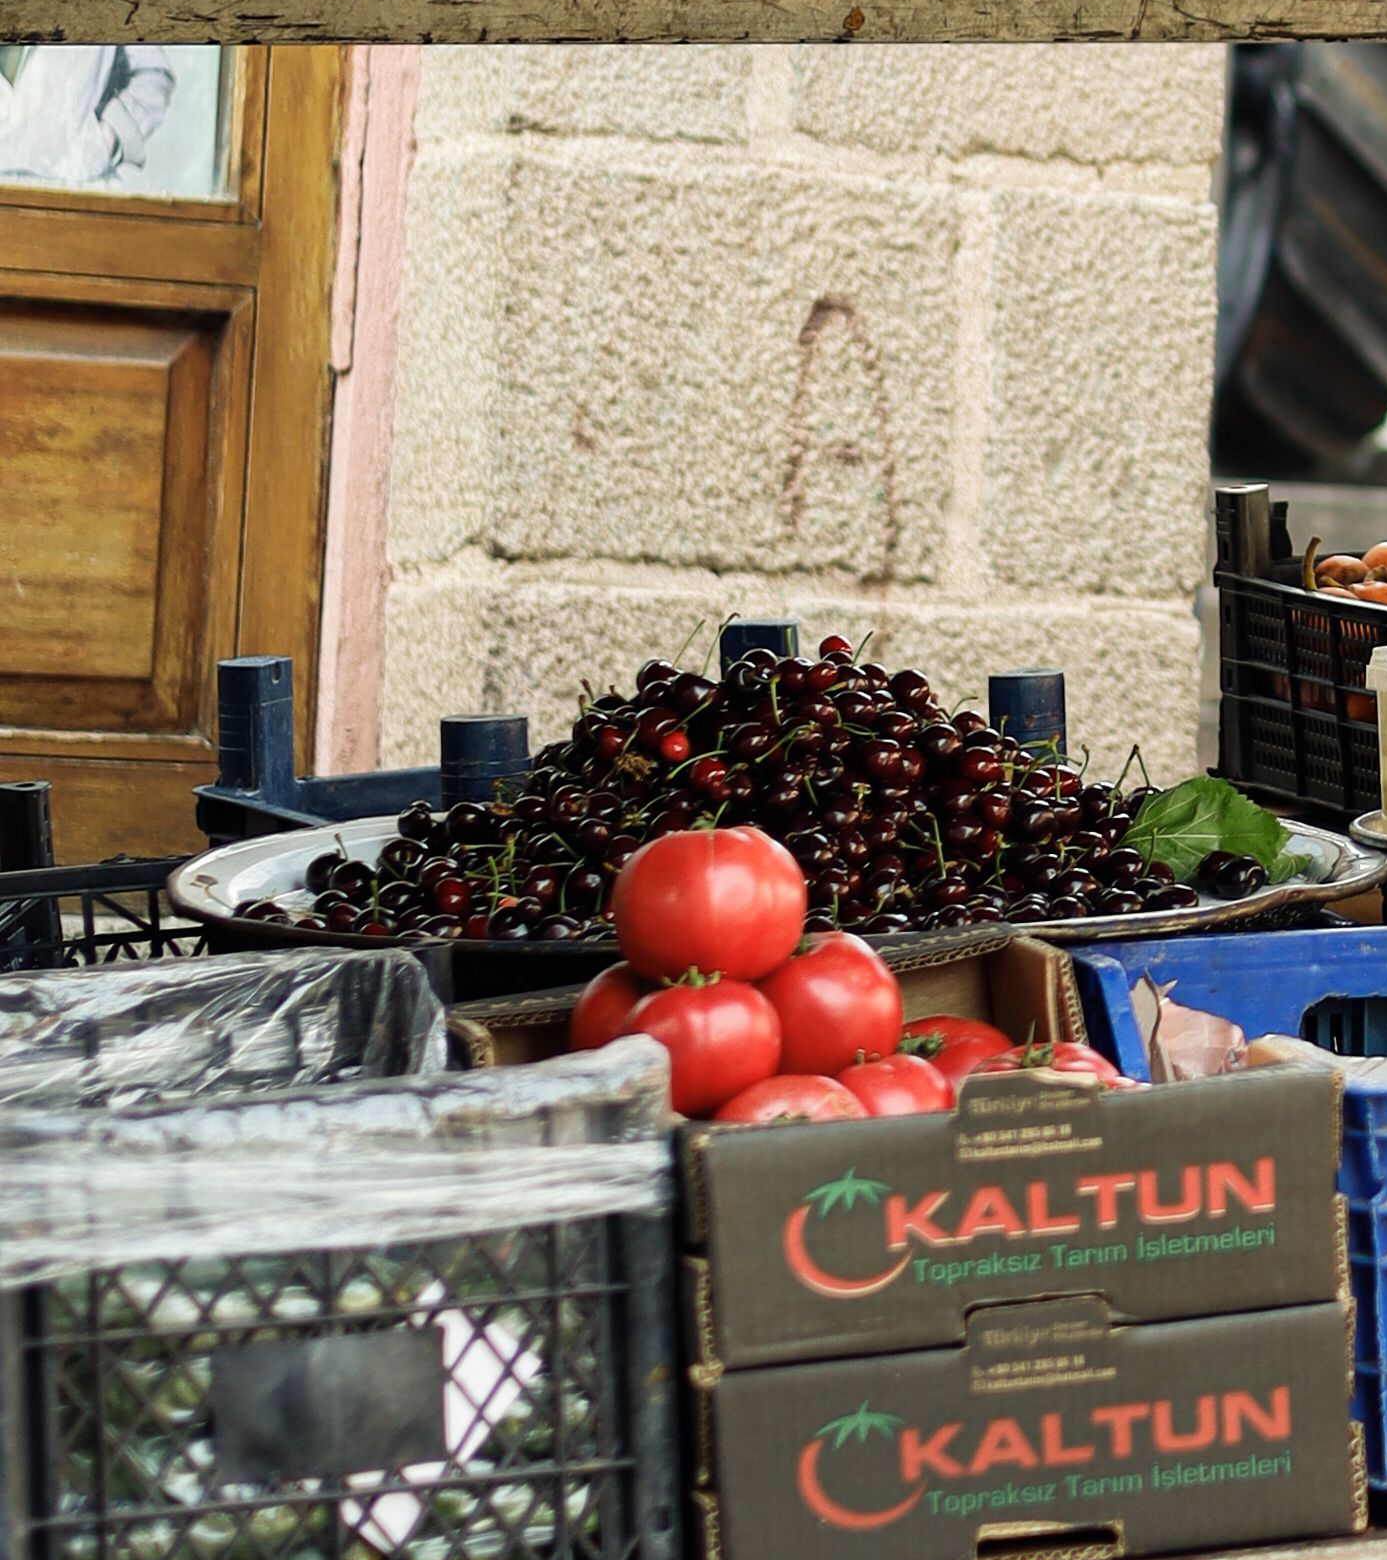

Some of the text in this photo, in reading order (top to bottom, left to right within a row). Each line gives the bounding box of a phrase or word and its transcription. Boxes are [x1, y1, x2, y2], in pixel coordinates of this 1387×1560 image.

[886, 1157, 1275, 1251] KALTUN
[913, 1223, 1275, 1284] Topraksız Tarım İşletmeleri
[899, 1386, 1291, 1480] KALTUN
[927, 1450, 1292, 1516] Topraksız Tarım İşletmeleri
